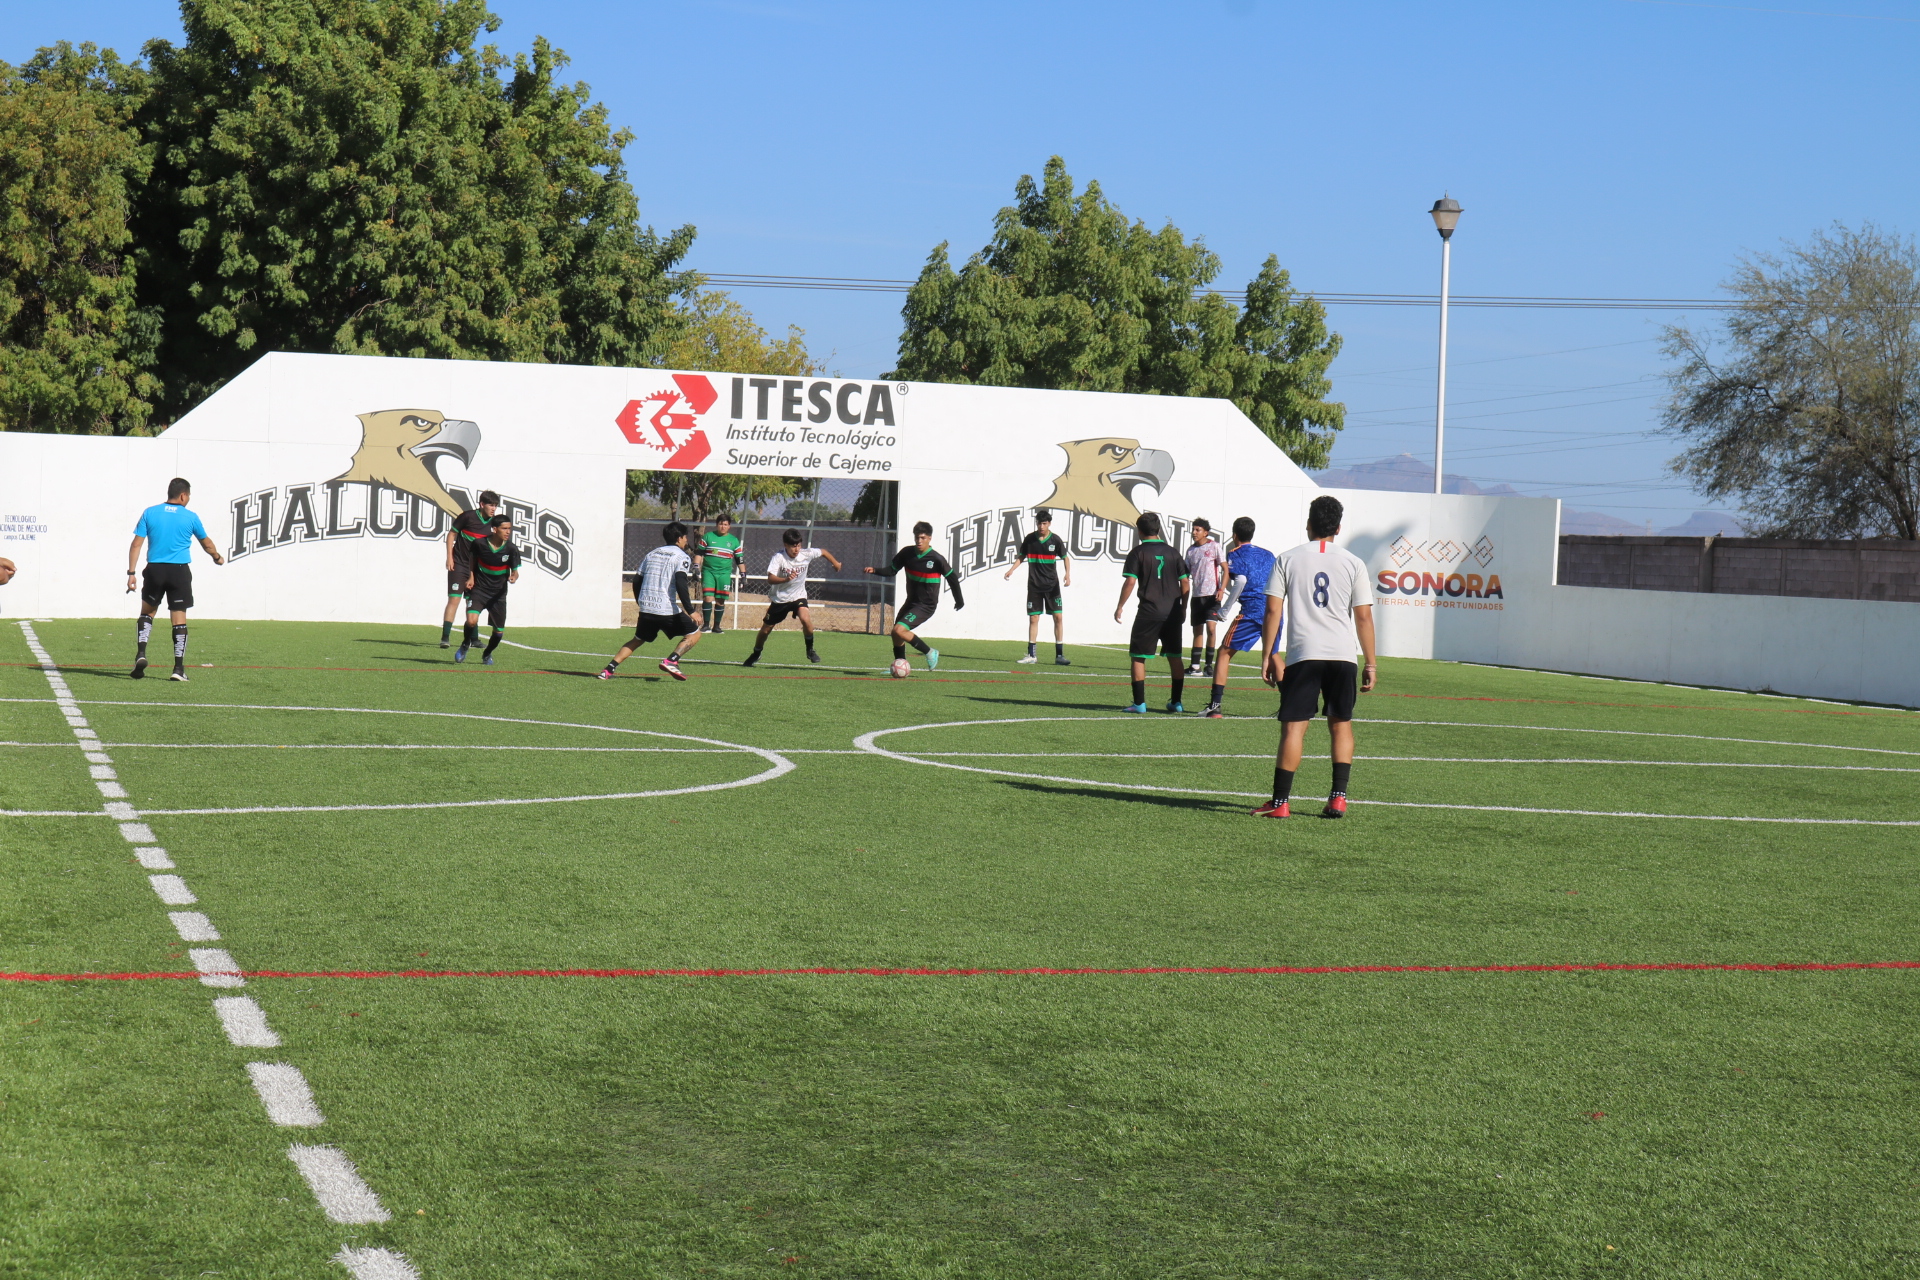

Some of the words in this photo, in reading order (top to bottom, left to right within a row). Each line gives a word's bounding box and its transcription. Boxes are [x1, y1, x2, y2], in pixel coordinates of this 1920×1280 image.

[731, 377, 896, 427] ITESCA
[726, 424, 795, 443] Instituto
[800, 427, 896, 450] Tecnológico
[726, 449, 798, 469] Superior
[802, 452, 822, 469] de
[829, 453, 892, 474] Cajeme
[18, 524, 25, 533] DE
[1155, 555, 1165, 579] 7
[1313, 571, 1330, 609] 8
[1376, 570, 1504, 600] SONORA
[1376, 597, 1410, 606] TIERRA
[1414, 599, 1426, 607] DE
[1430, 601, 1504, 611] OPORTUNIDADES
[904, 612, 917, 623] 28
